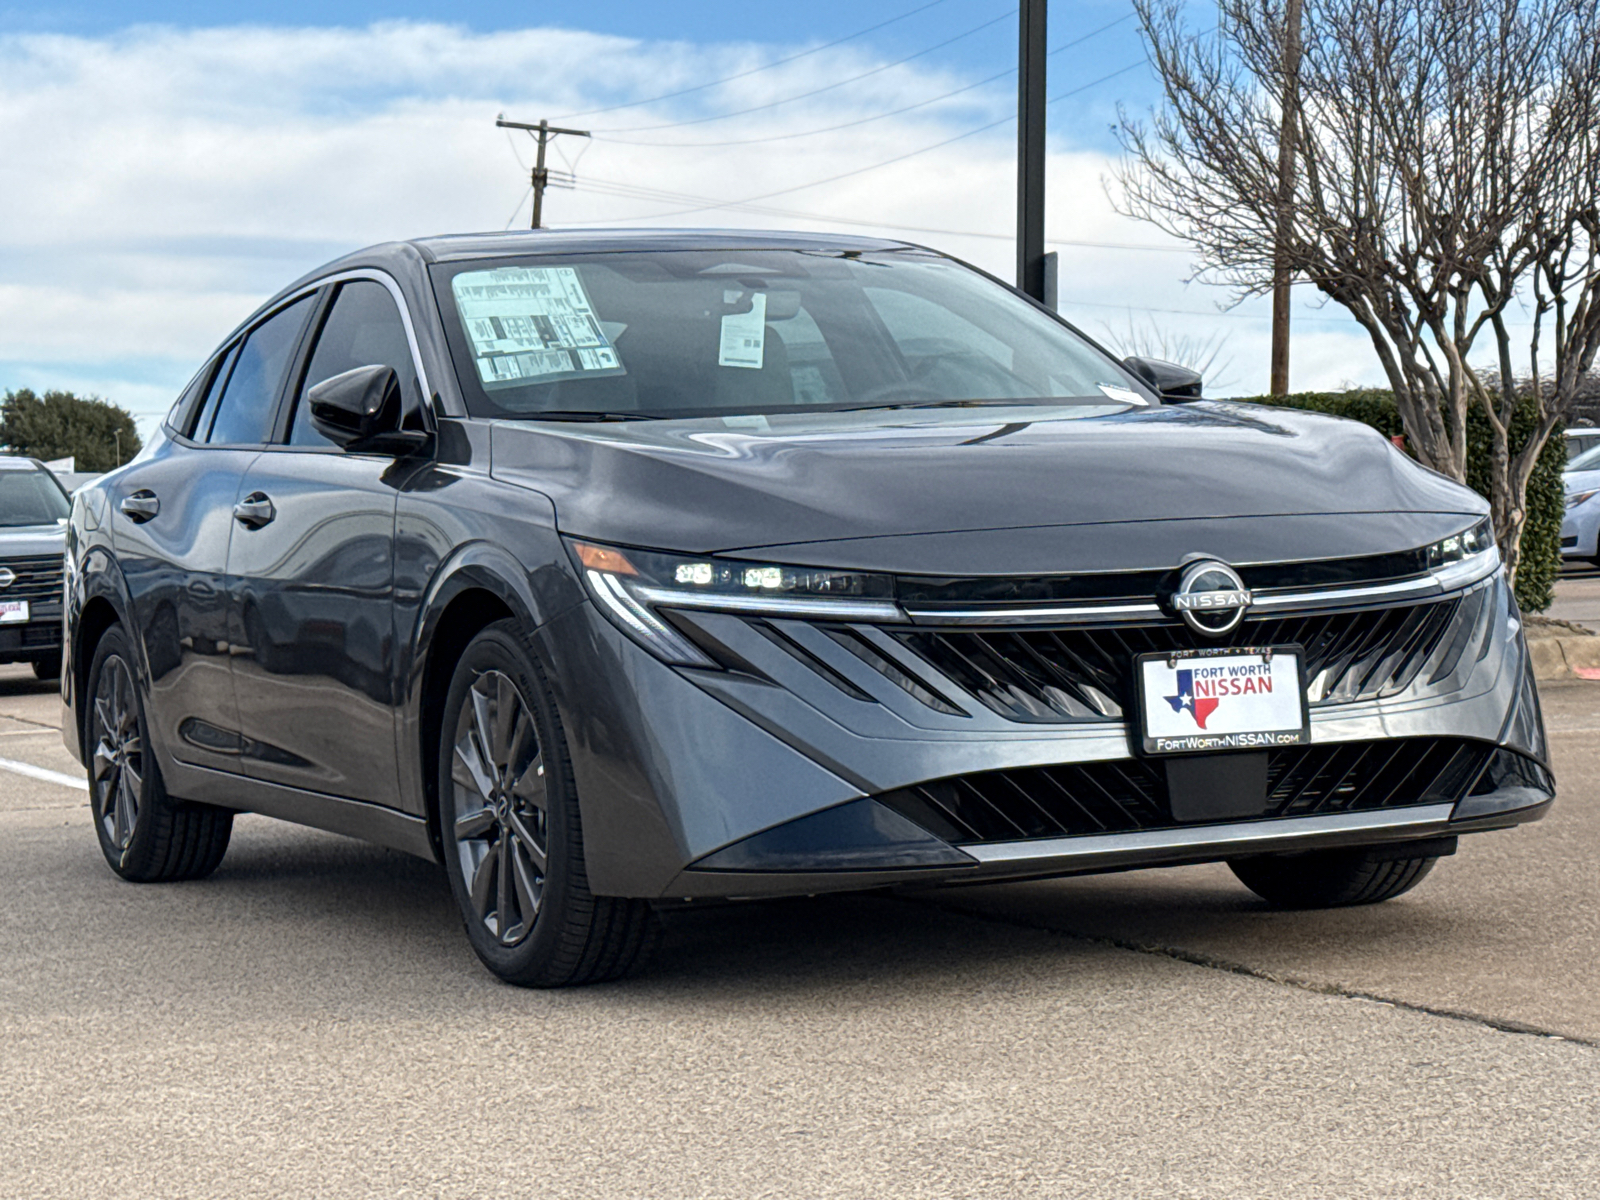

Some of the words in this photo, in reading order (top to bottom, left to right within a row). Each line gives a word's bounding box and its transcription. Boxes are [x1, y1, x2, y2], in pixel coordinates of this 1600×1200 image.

[1176, 594, 1251, 608] NISSAN
[1170, 650, 1194, 658] FORT
[1199, 648, 1230, 656] WORTH
[1194, 667, 1225, 679] FORT
[1228, 664, 1271, 677] WORTH
[1195, 676, 1272, 697] NISSAN
